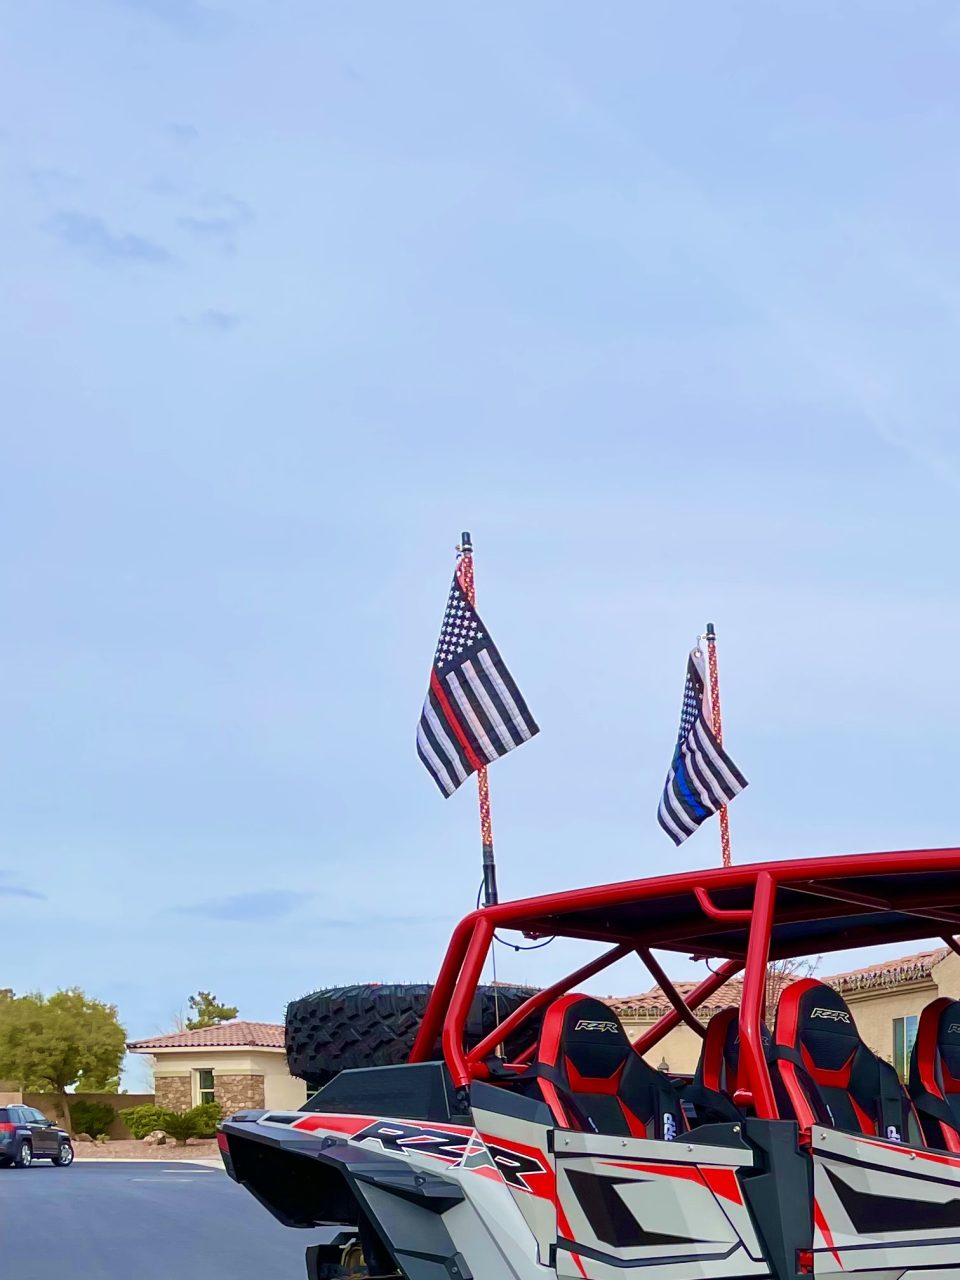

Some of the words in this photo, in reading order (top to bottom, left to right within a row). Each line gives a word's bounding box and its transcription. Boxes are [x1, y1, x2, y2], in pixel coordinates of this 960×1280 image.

[811, 1008, 850, 1023] RZR
[575, 1020, 618, 1033] RZR
[350, 1119, 547, 1193] RZR
